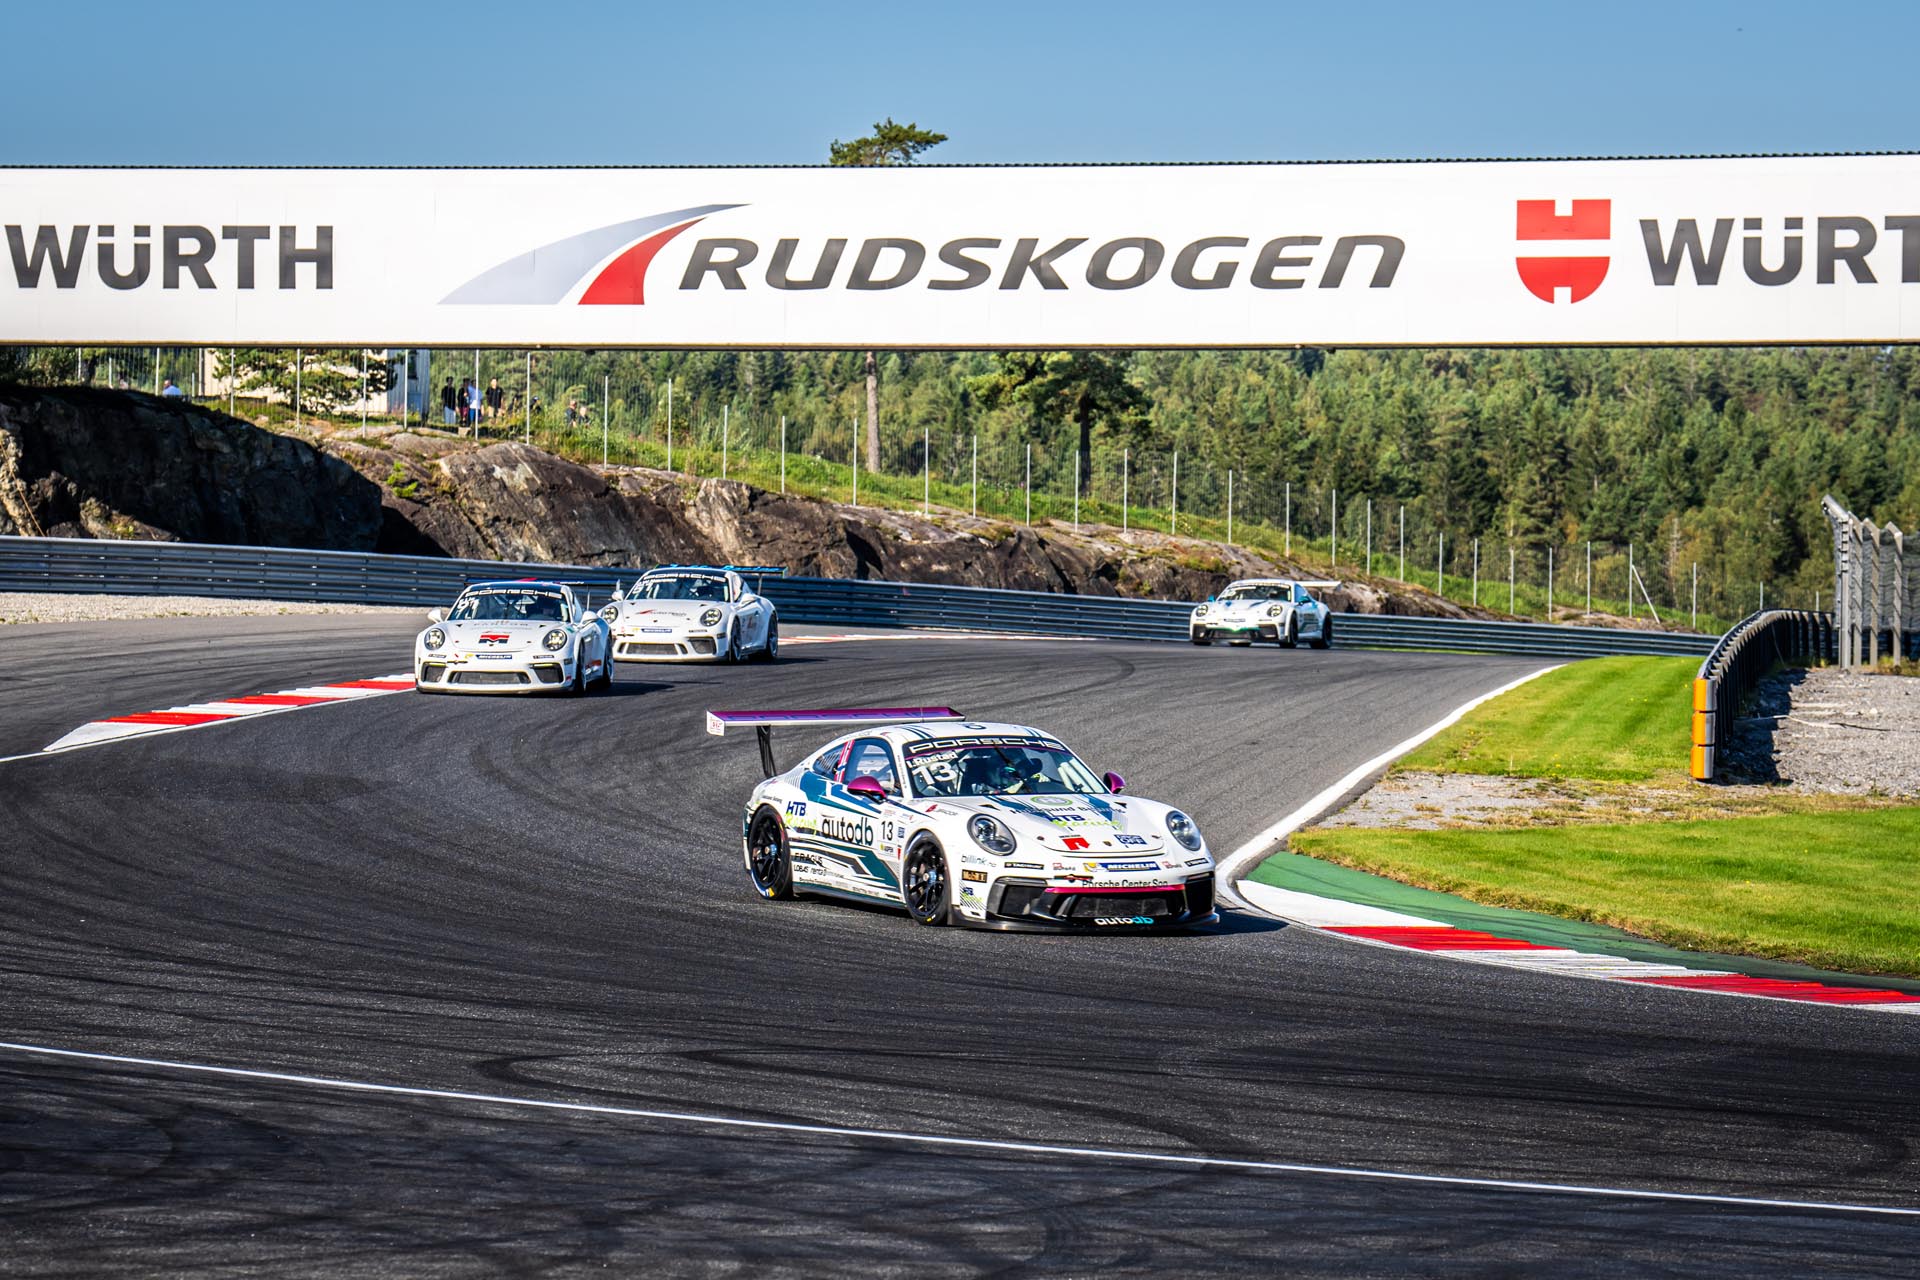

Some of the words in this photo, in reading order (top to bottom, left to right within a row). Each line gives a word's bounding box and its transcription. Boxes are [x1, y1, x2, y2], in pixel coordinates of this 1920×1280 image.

[4, 225, 334, 290] WÜRTH
[678, 235, 1407, 291] RUDSKOGEN
[465, 589, 562, 599] PORSCHE
[910, 738, 1066, 754] PORSCHE
[912, 762, 958, 785] 13
[786, 801, 807, 816] HTB
[822, 817, 874, 847] autodb
[881, 820, 894, 841] 13
[1106, 862, 1158, 871] MICHELIN
[1082, 879, 1120, 888] Porsche
[1122, 879, 1151, 888] Center
[1094, 916, 1155, 926] autodb
